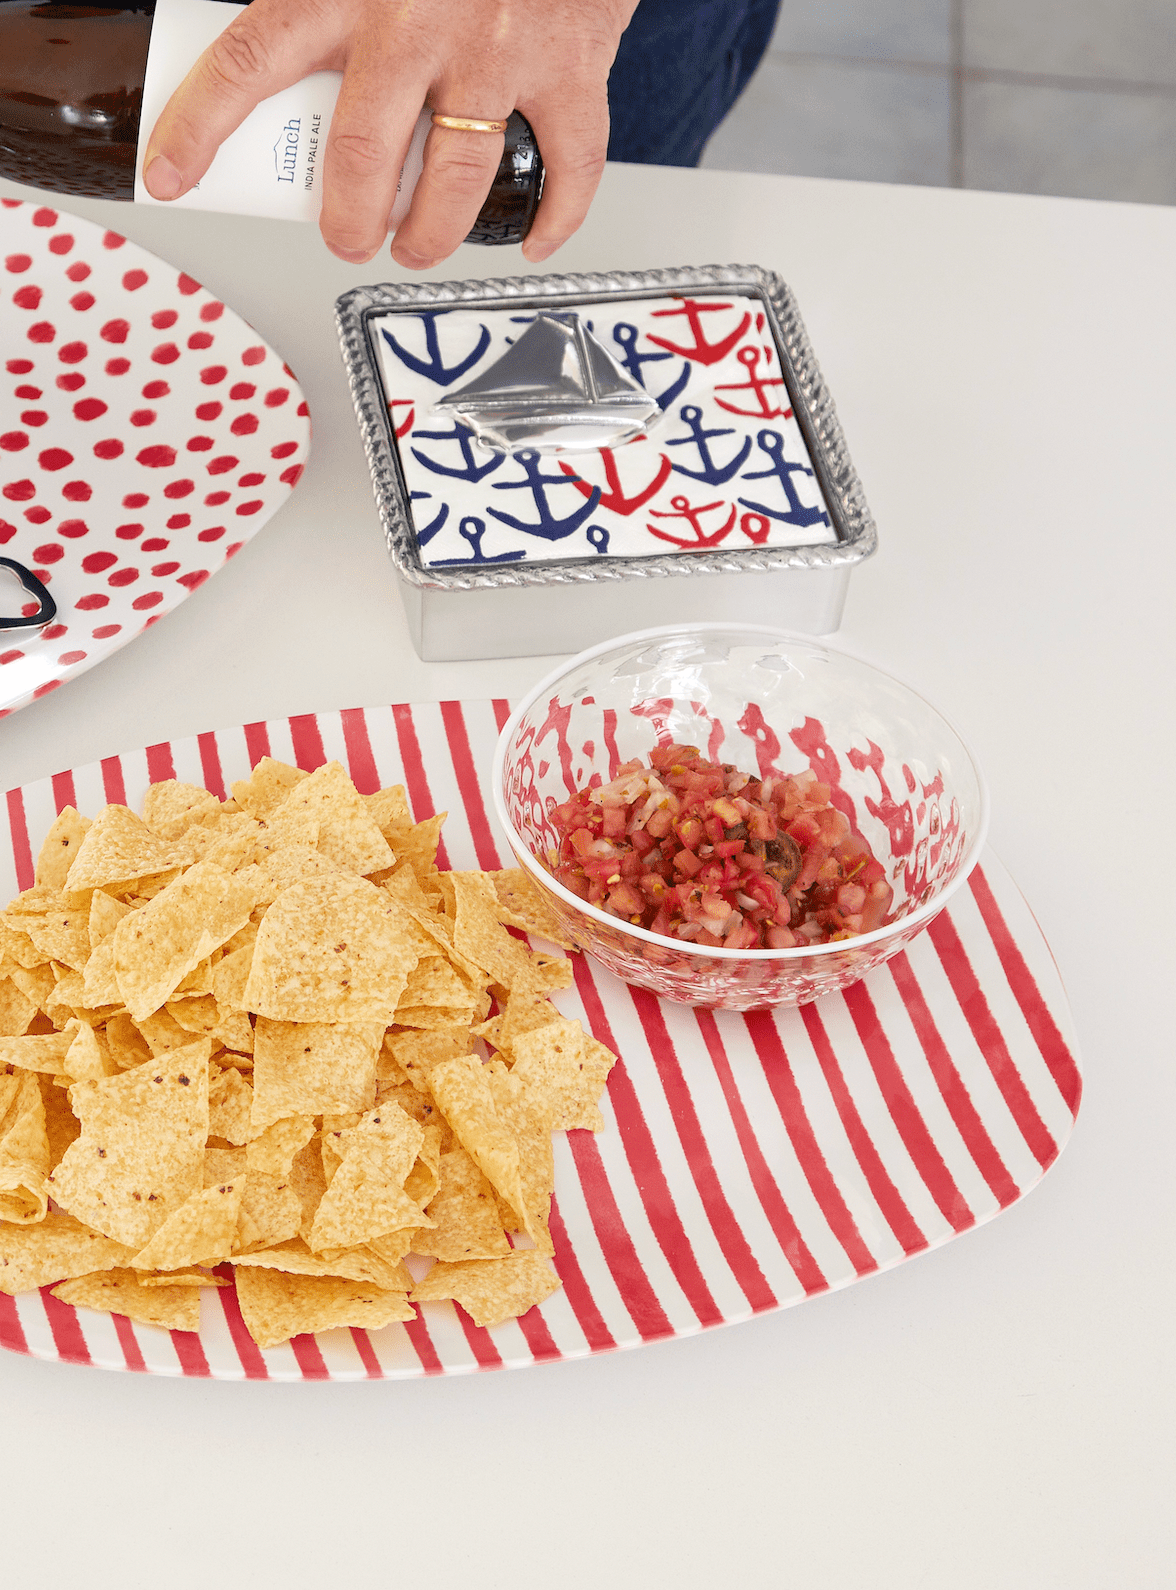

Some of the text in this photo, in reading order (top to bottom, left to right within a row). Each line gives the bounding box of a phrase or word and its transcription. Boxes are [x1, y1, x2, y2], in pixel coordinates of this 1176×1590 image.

[277, 117, 301, 183] Lunch
[304, 114, 322, 191] INDIA PALE ALE
